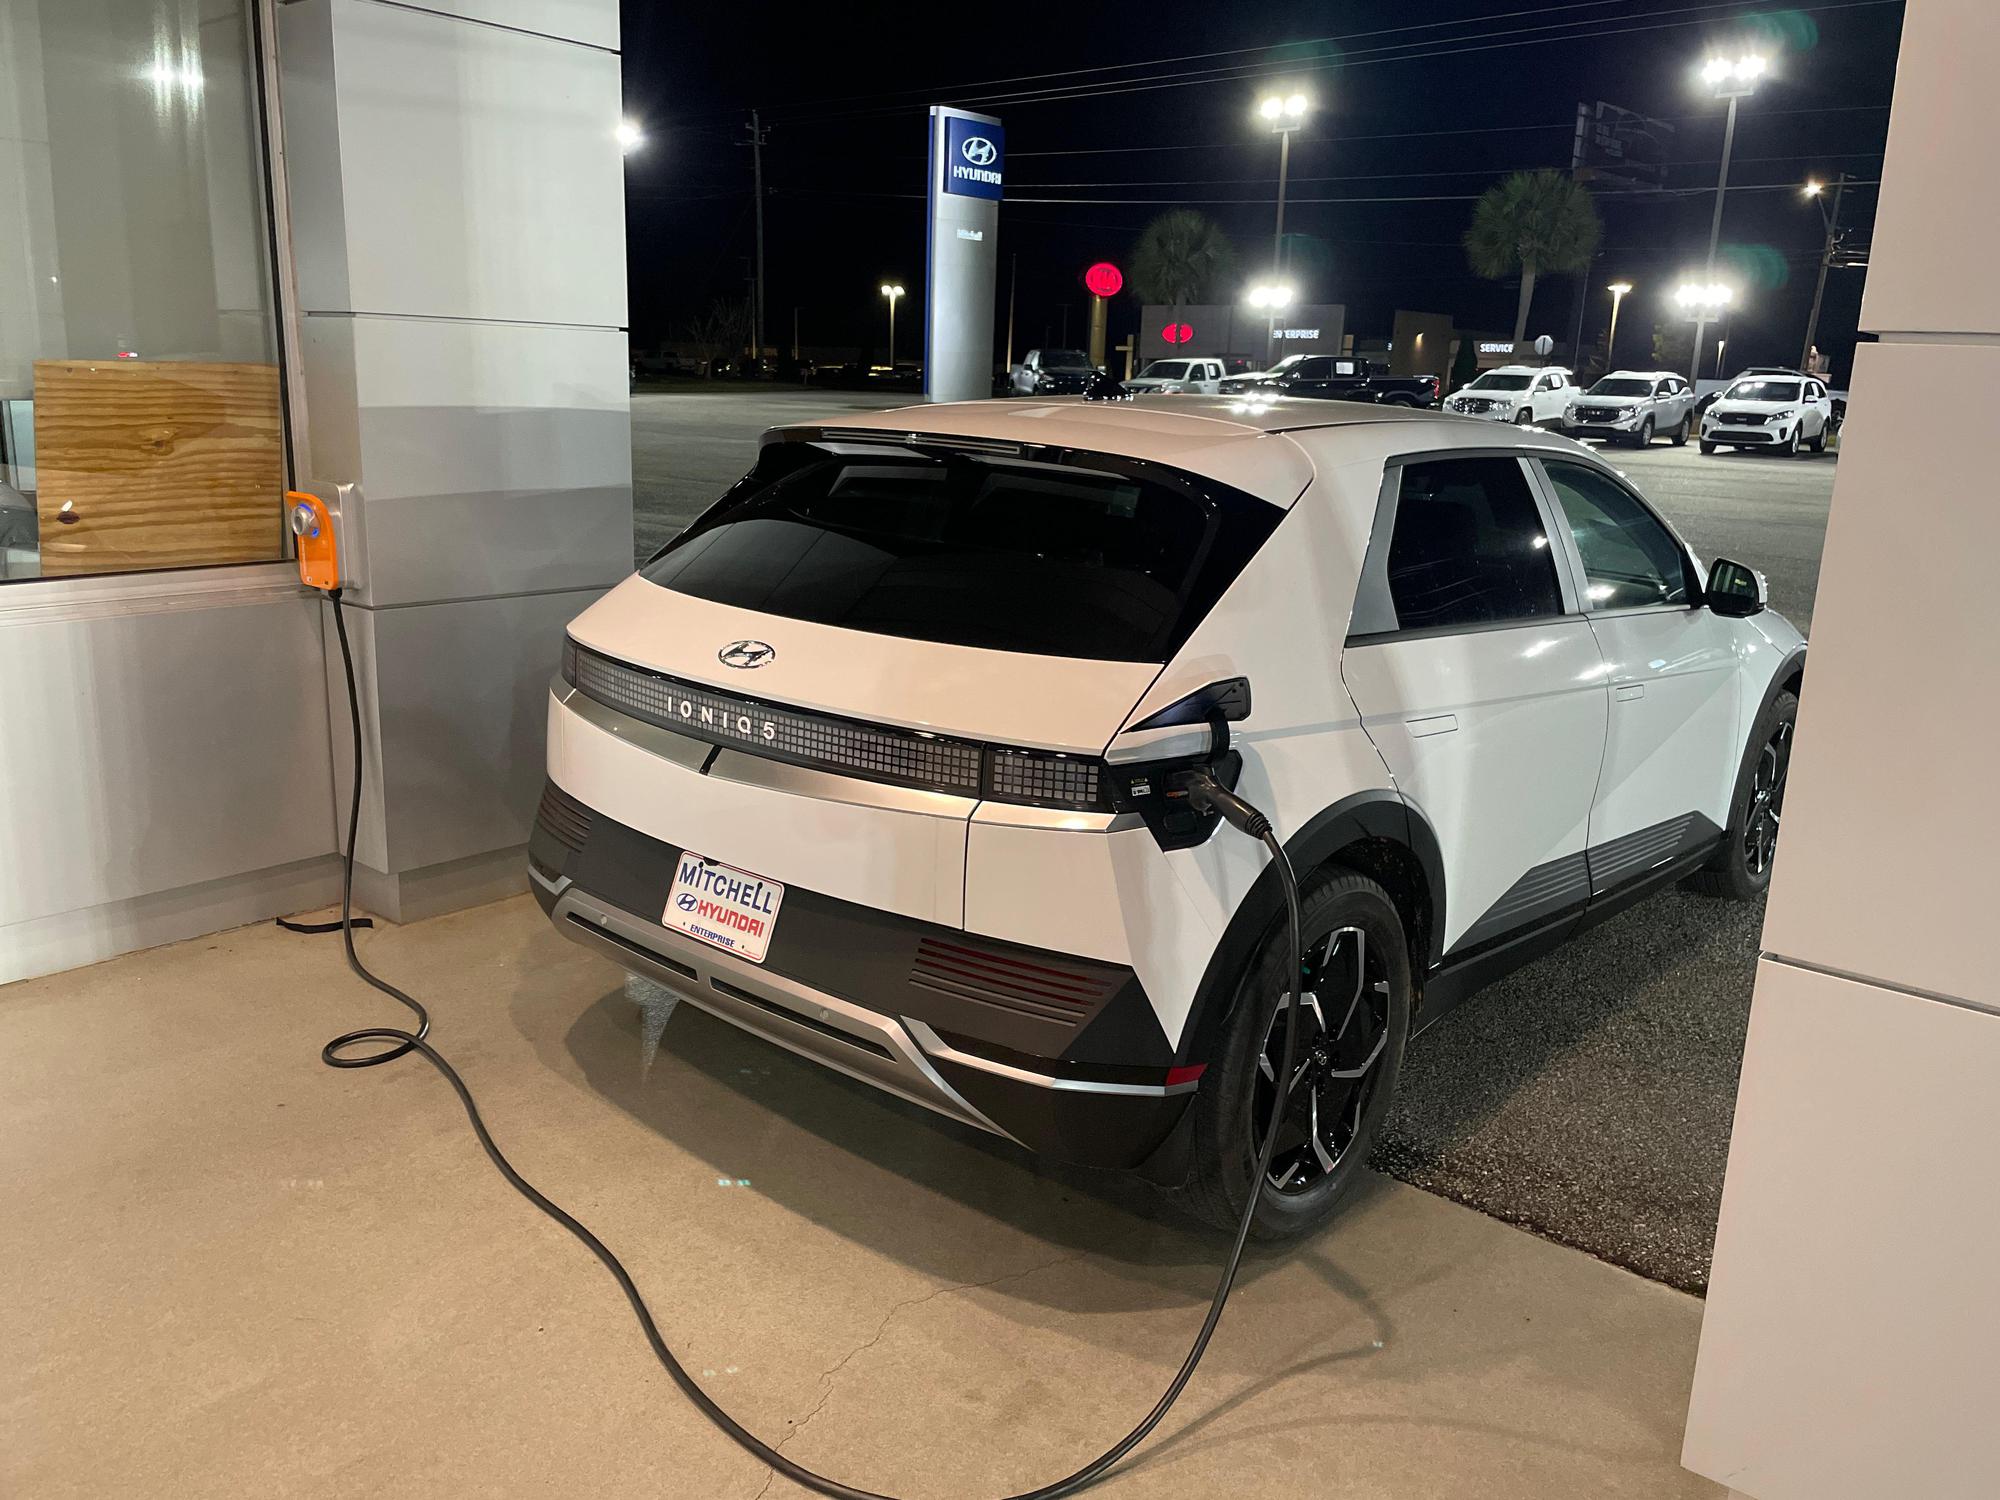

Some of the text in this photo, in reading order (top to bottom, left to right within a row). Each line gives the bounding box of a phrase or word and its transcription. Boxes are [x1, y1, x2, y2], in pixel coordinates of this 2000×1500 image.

[953, 165, 1002, 185] HYUNDAI
[1480, 343, 1514, 353] SERVICE
[678, 862, 772, 914] MITCHELL
[697, 899, 765, 938] HYUNDAI
[689, 924, 735, 948] ENTERPRISE
